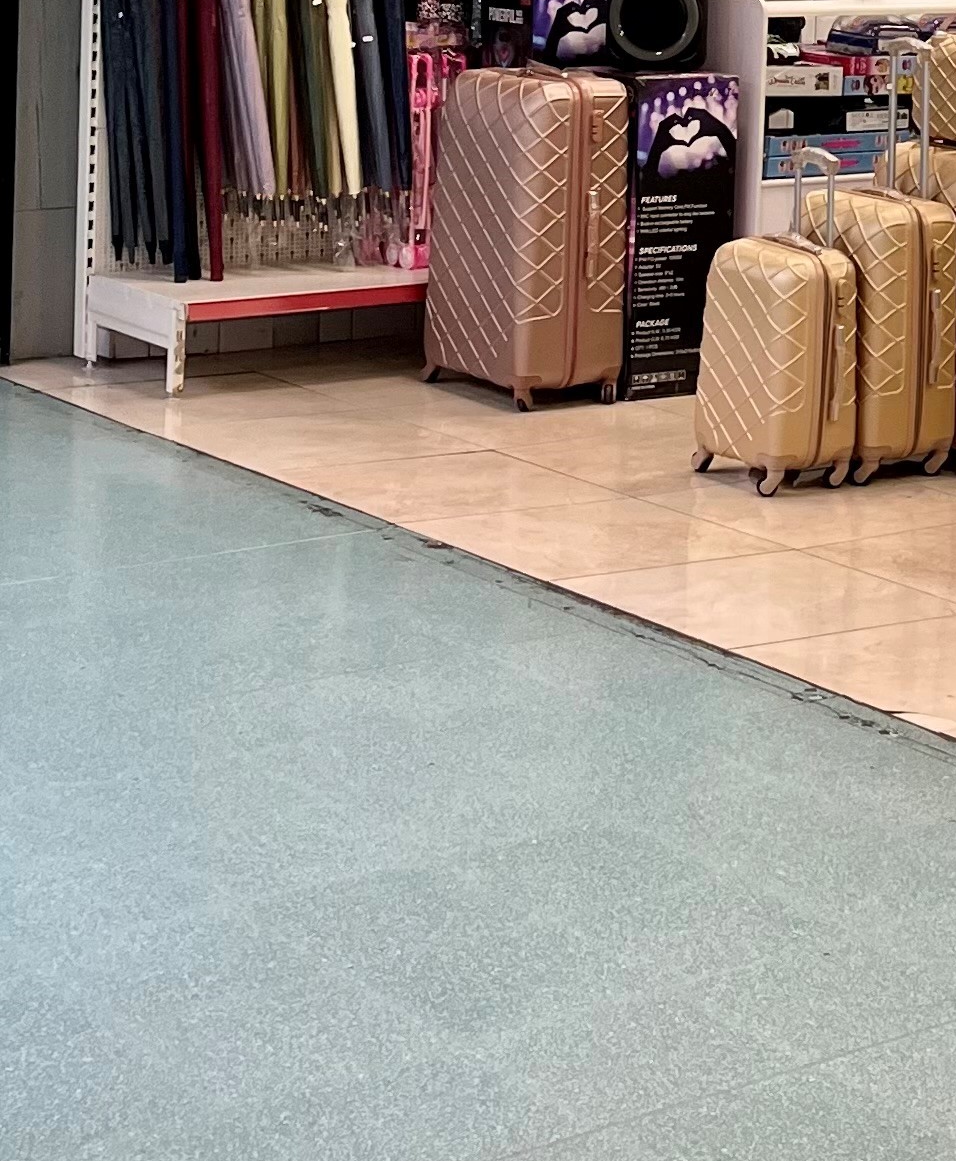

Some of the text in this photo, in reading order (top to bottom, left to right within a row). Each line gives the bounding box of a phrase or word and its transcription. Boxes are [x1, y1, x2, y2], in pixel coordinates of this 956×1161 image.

[640, 194, 678, 205] FEATURES
[638, 243, 698, 256] SPECIFICATIONS
[635, 318, 670, 329] PACKAGE
